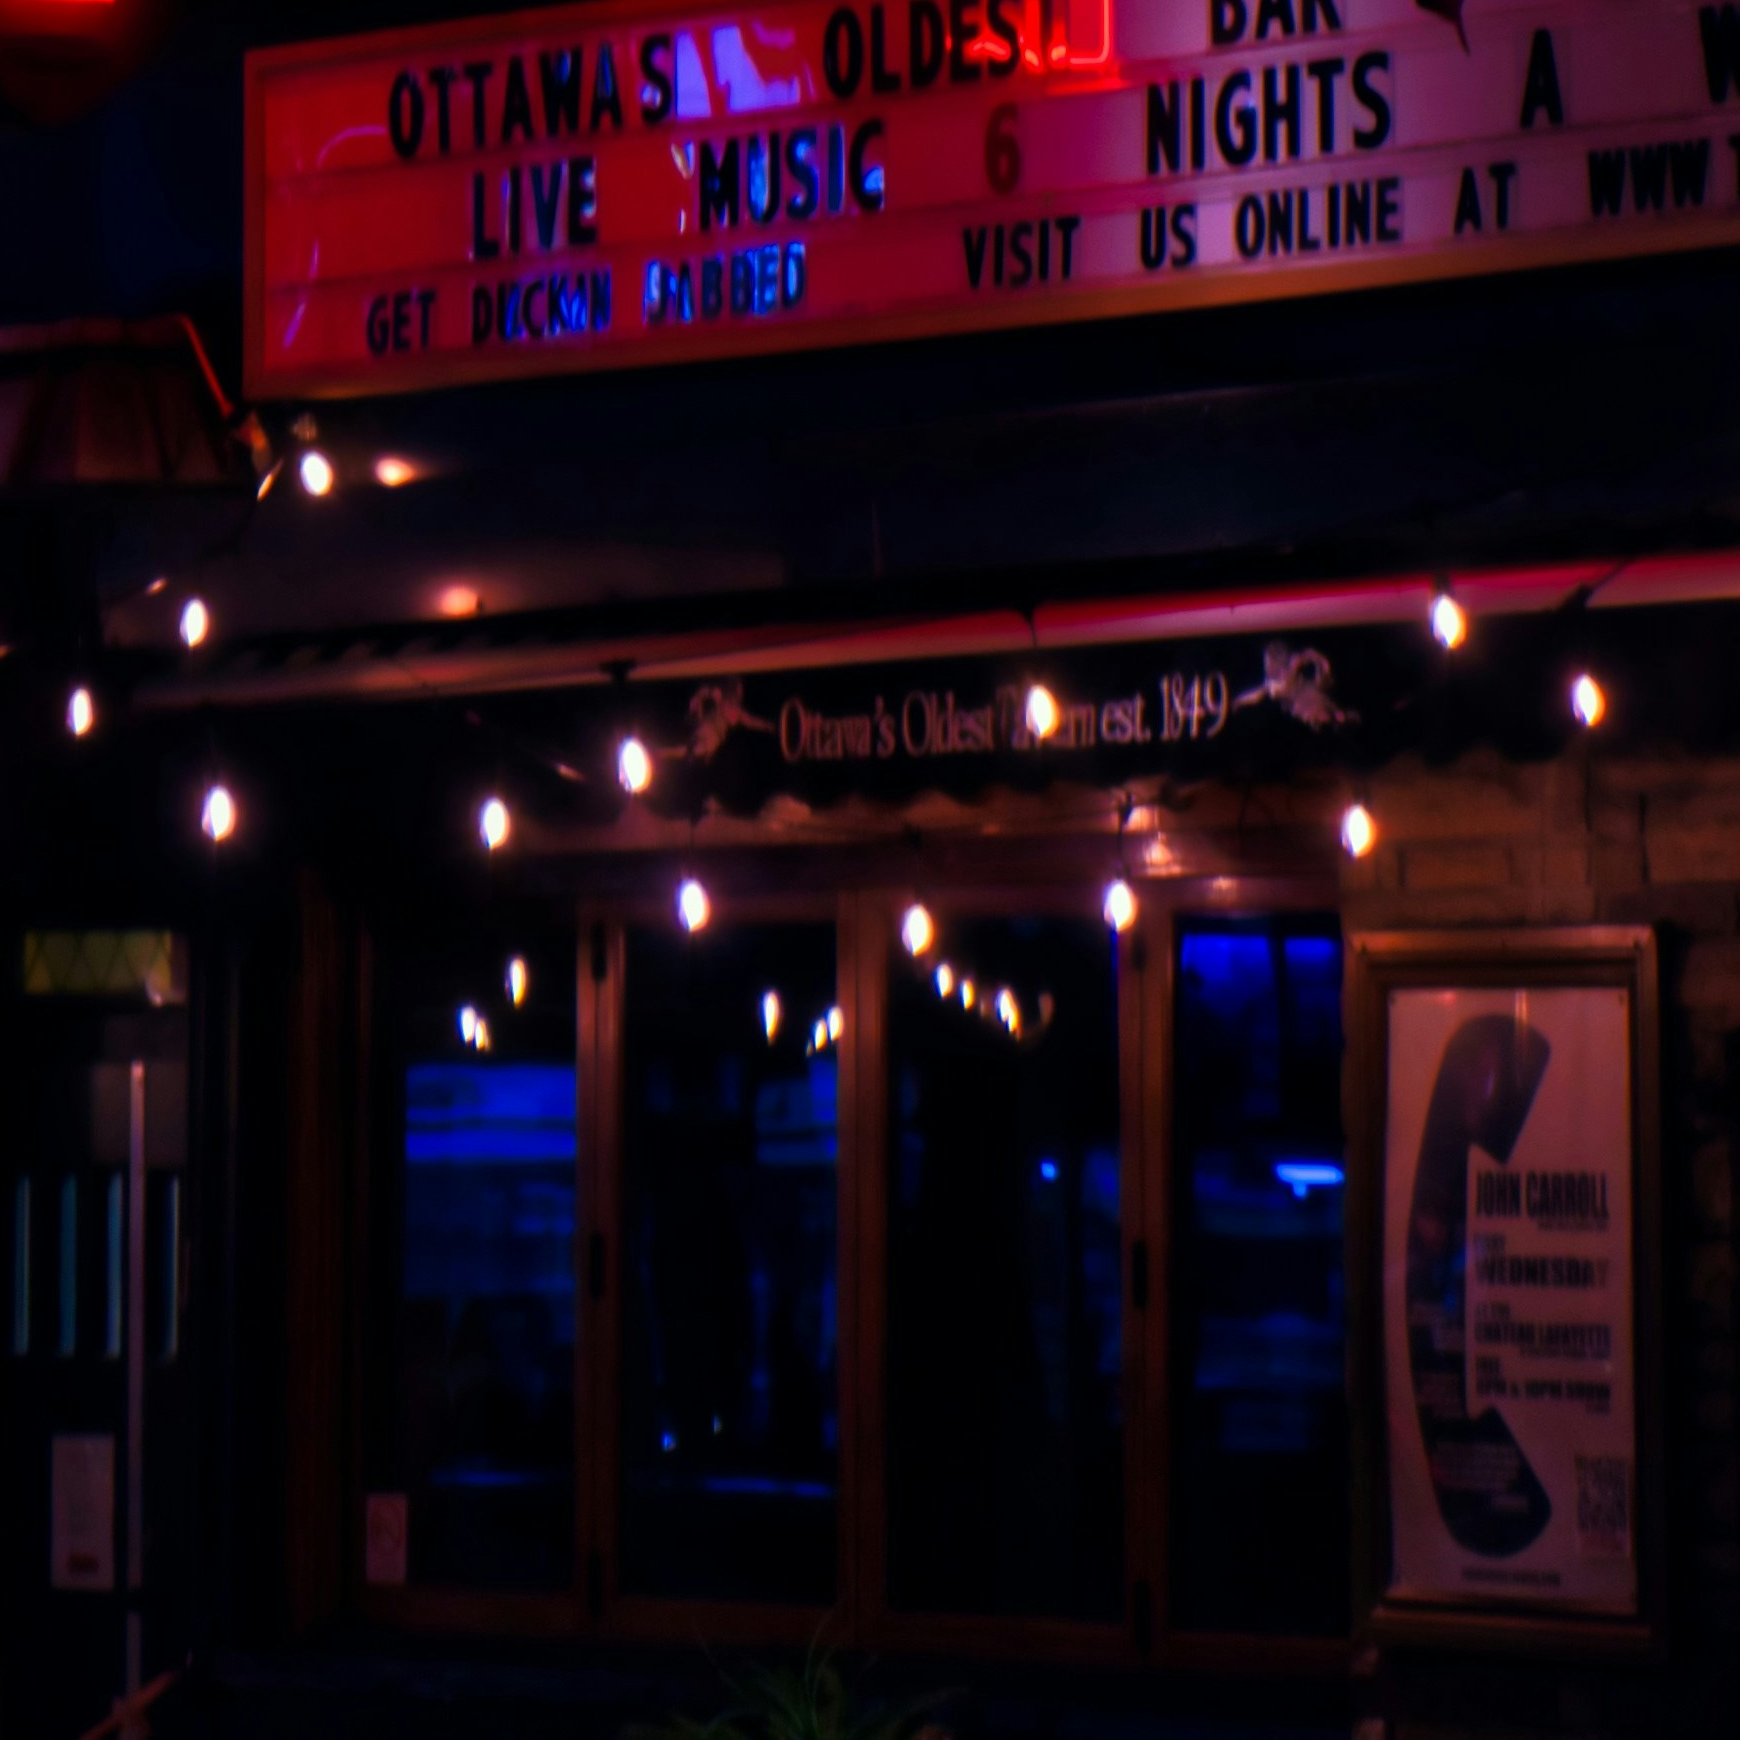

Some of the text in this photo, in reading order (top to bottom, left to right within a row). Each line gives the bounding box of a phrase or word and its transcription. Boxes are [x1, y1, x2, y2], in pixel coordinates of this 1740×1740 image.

[470, 159, 596, 260] LIVE
[700, 120, 886, 233] MUSIC
[985, 102, 1021, 195] 6
[1146, 52, 1390, 176] NIGHTS
[1520, 29, 1564, 128] A
[367, 288, 436, 357] GET
[963, 217, 1078, 290] VISIT
[1140, 206, 1197, 269] US
[1237, 178, 1400, 258] ONLINE
[1454, 164, 1515, 233] AT
[780, 670, 1228, 764] Ottawa's Oldest Tarn est. 1849
[1476, 1170, 1609, 1221] JOHN CARROLL
[1475, 1254, 1610, 1288] WEDNESDAY
